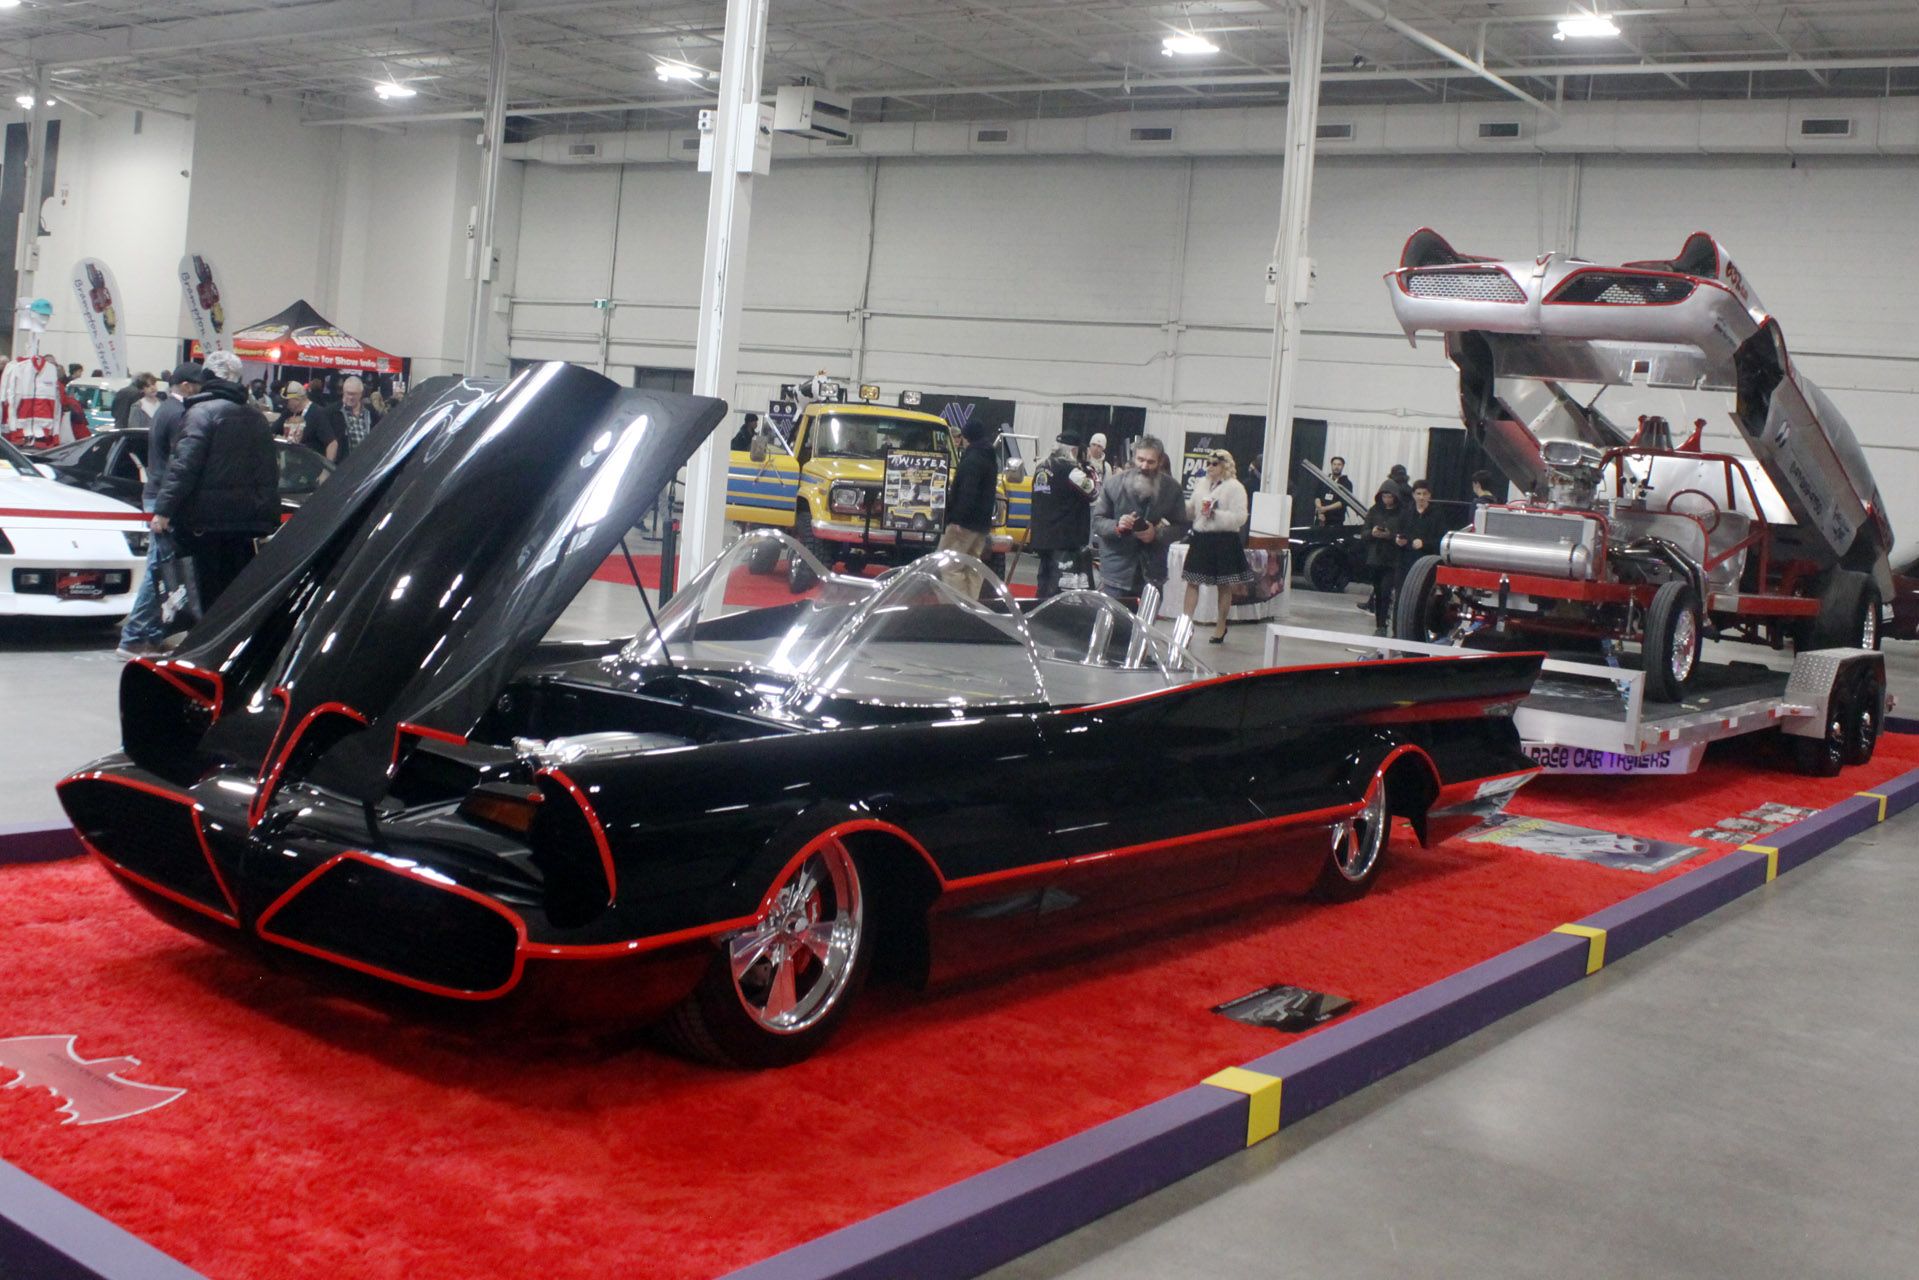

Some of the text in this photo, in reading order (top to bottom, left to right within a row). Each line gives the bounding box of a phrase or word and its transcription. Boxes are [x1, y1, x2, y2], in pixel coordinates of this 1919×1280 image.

[181, 272, 206, 336] Brampton
[74, 279, 112, 377] Brampton Street
[298, 352, 320, 363] Scan
[321, 355, 334, 365] for
[335, 356, 359, 367] Show
[888, 455, 947, 469] TWISTER
[1573, 748, 1604, 769] CAR
